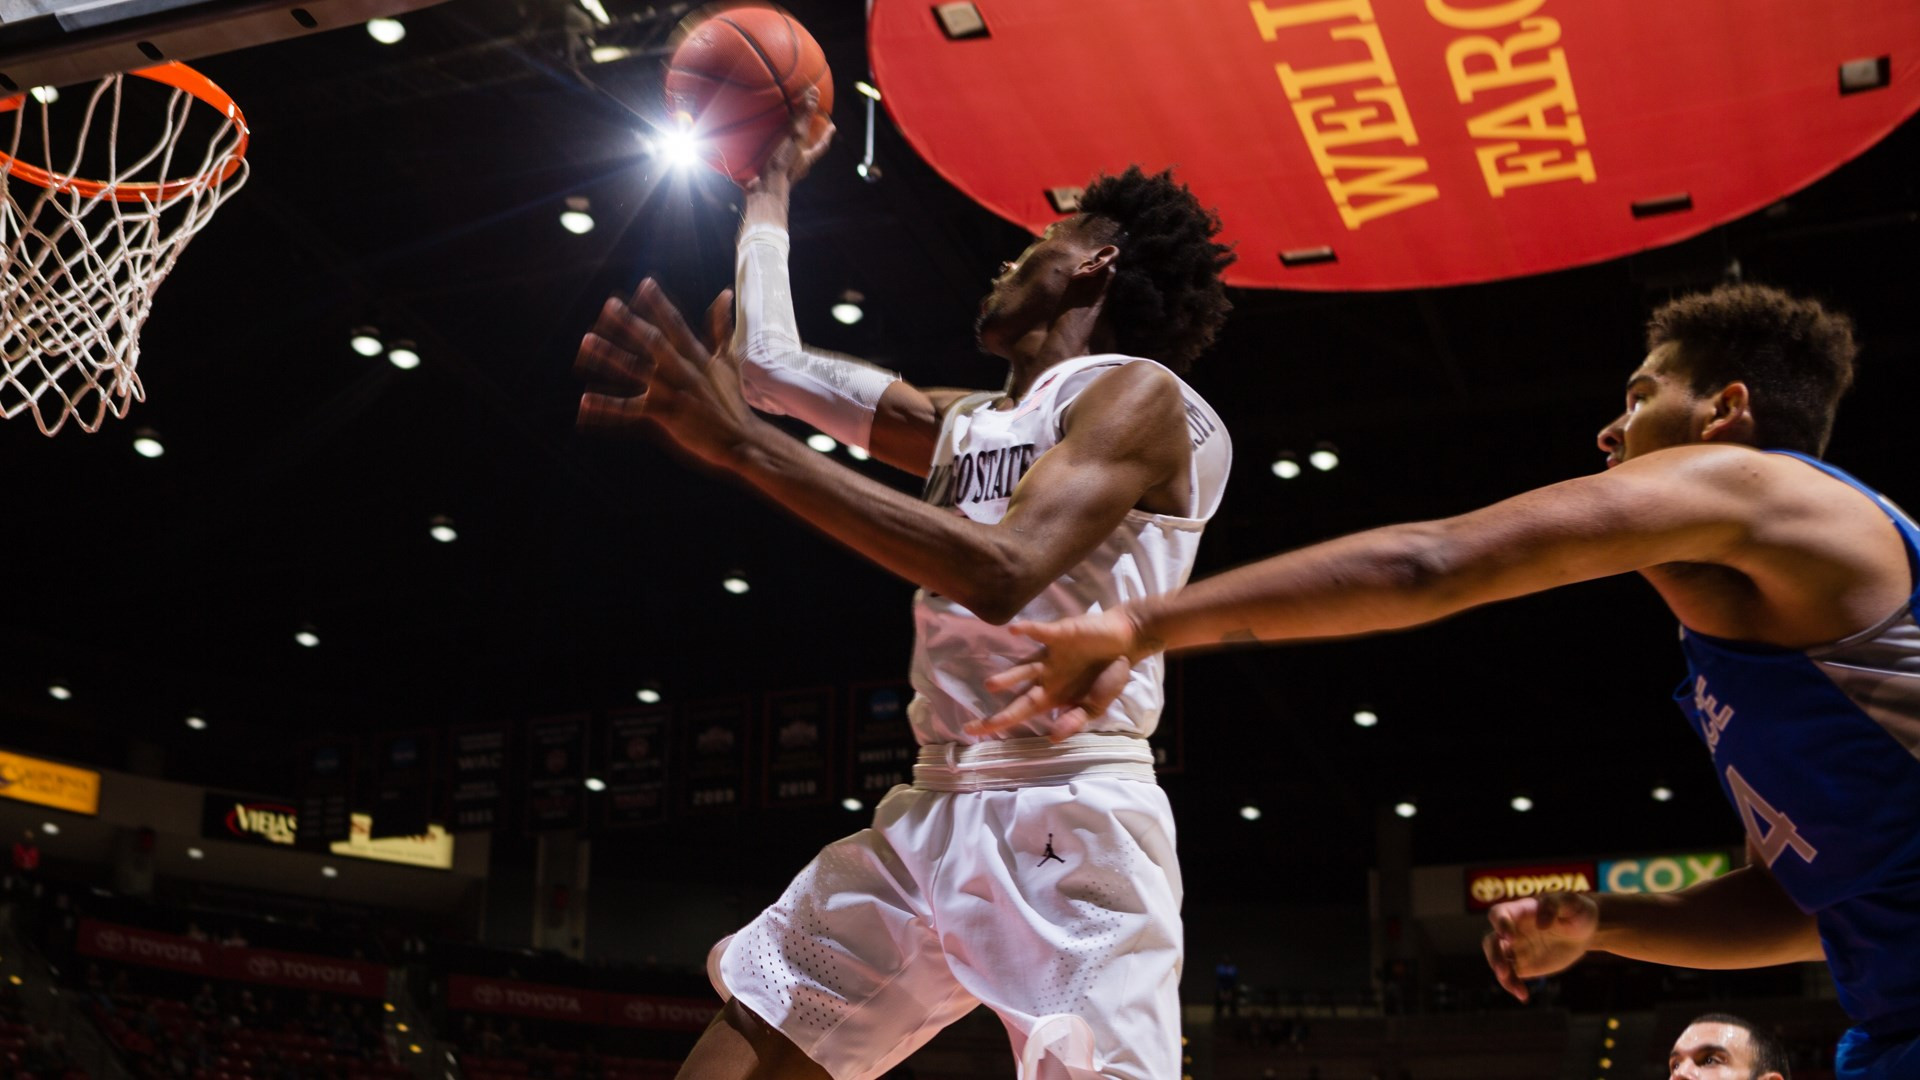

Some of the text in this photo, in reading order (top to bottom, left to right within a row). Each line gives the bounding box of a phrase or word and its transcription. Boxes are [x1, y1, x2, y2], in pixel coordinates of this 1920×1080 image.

[1725, 763, 1819, 869] 4
[1504, 872, 1592, 898] TOYOTA
[1607, 855, 1722, 894] COX
[128, 936, 205, 967] TOYOTA
[282, 957, 363, 986] TOYOTA
[503, 987, 581, 1014] TOYOTA
